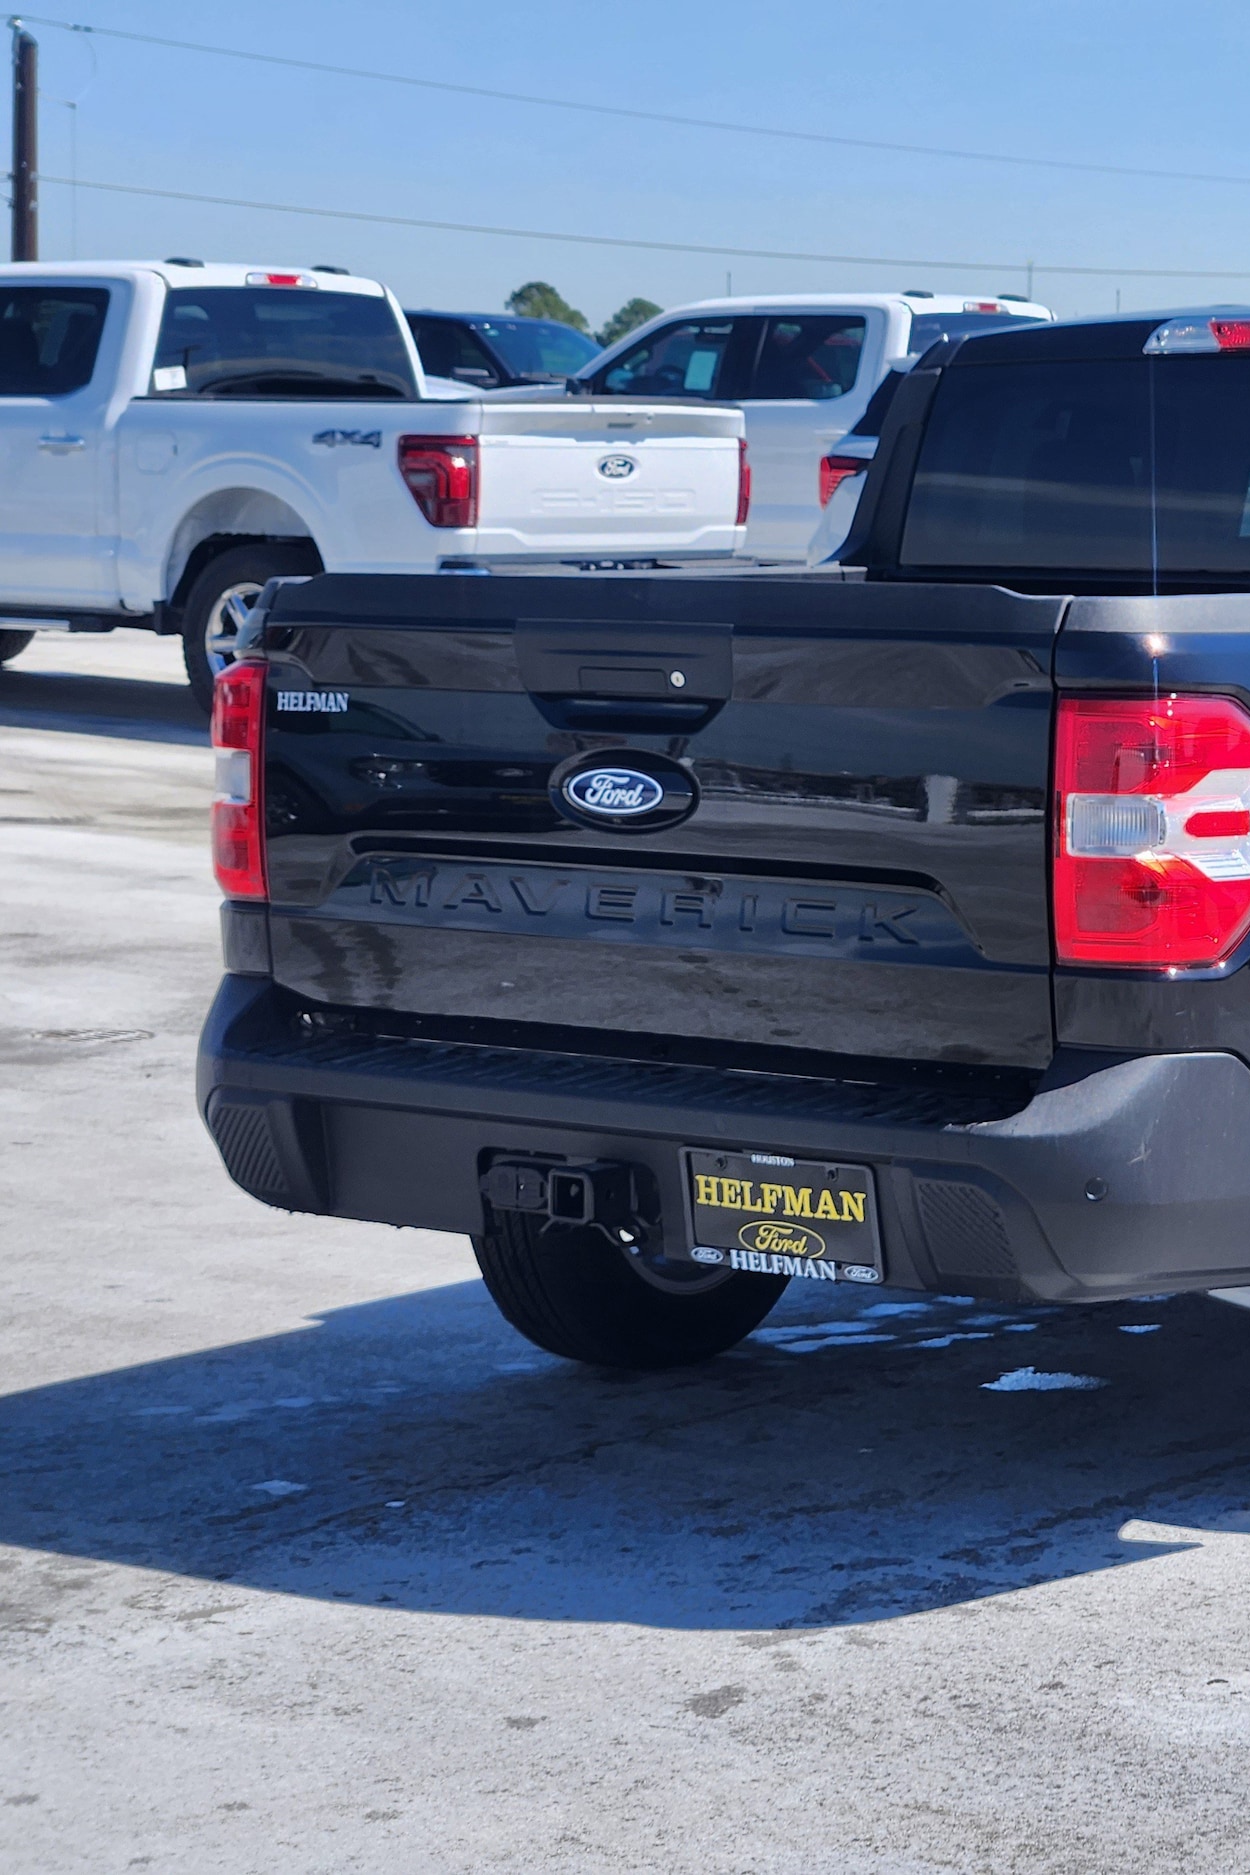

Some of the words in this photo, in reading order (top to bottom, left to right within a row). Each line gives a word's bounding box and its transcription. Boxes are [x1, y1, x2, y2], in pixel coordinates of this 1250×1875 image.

[531, 488, 697, 514] F-150
[277, 691, 349, 712] HELFMAN
[584, 773, 644, 807] Ford
[369, 867, 920, 946] MAVERICK
[750, 1153, 796, 1168] HOUSTON
[695, 1173, 867, 1223] HELFMAN
[754, 1223, 809, 1256] Ford
[730, 1249, 837, 1281] HELFMAN
